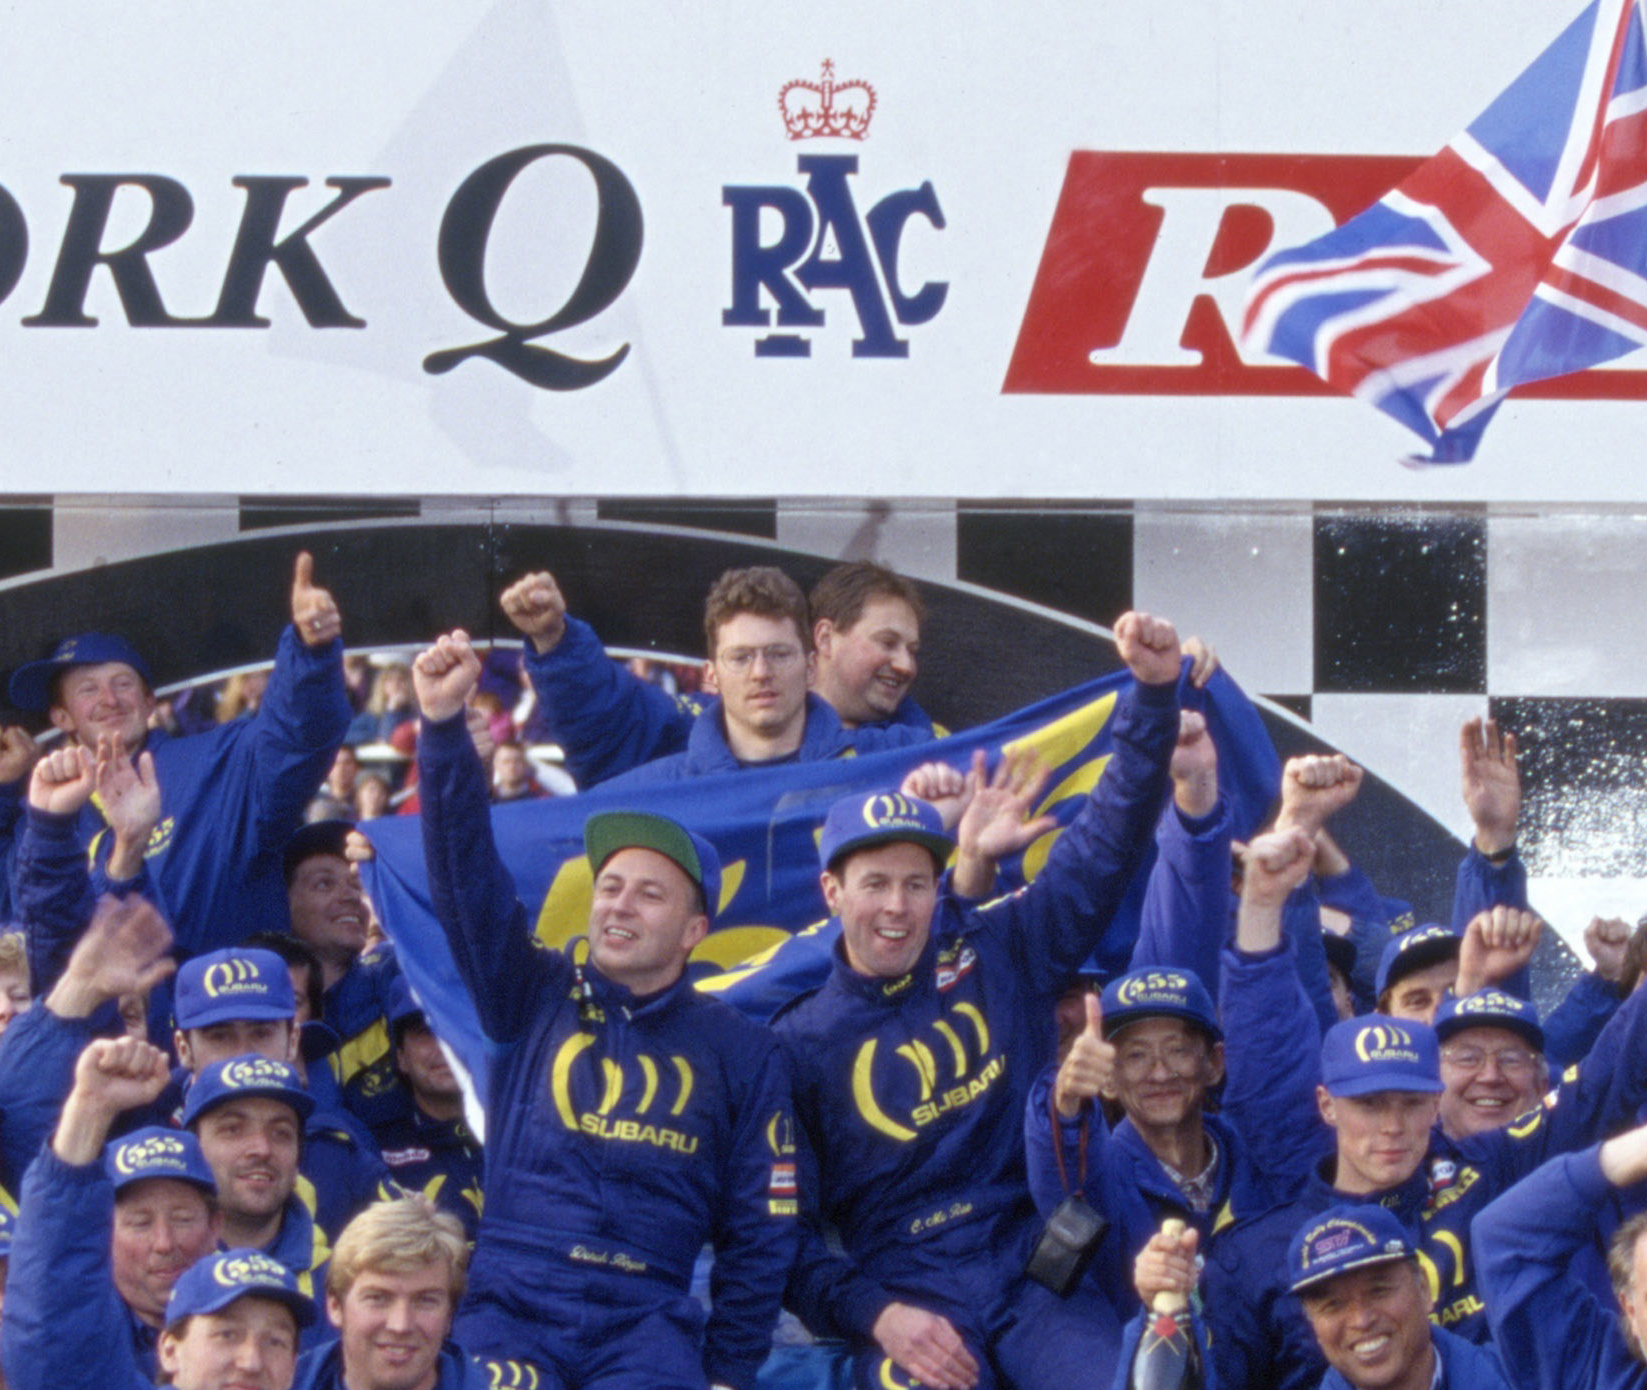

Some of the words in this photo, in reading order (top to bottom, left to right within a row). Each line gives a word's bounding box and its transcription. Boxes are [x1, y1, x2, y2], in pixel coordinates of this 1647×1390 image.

[422, 142, 645, 392] Q
[722, 154, 950, 358] RAC
[580, 1112, 699, 1155] SUBARU
[912, 1053, 1006, 1127] SUBARU
